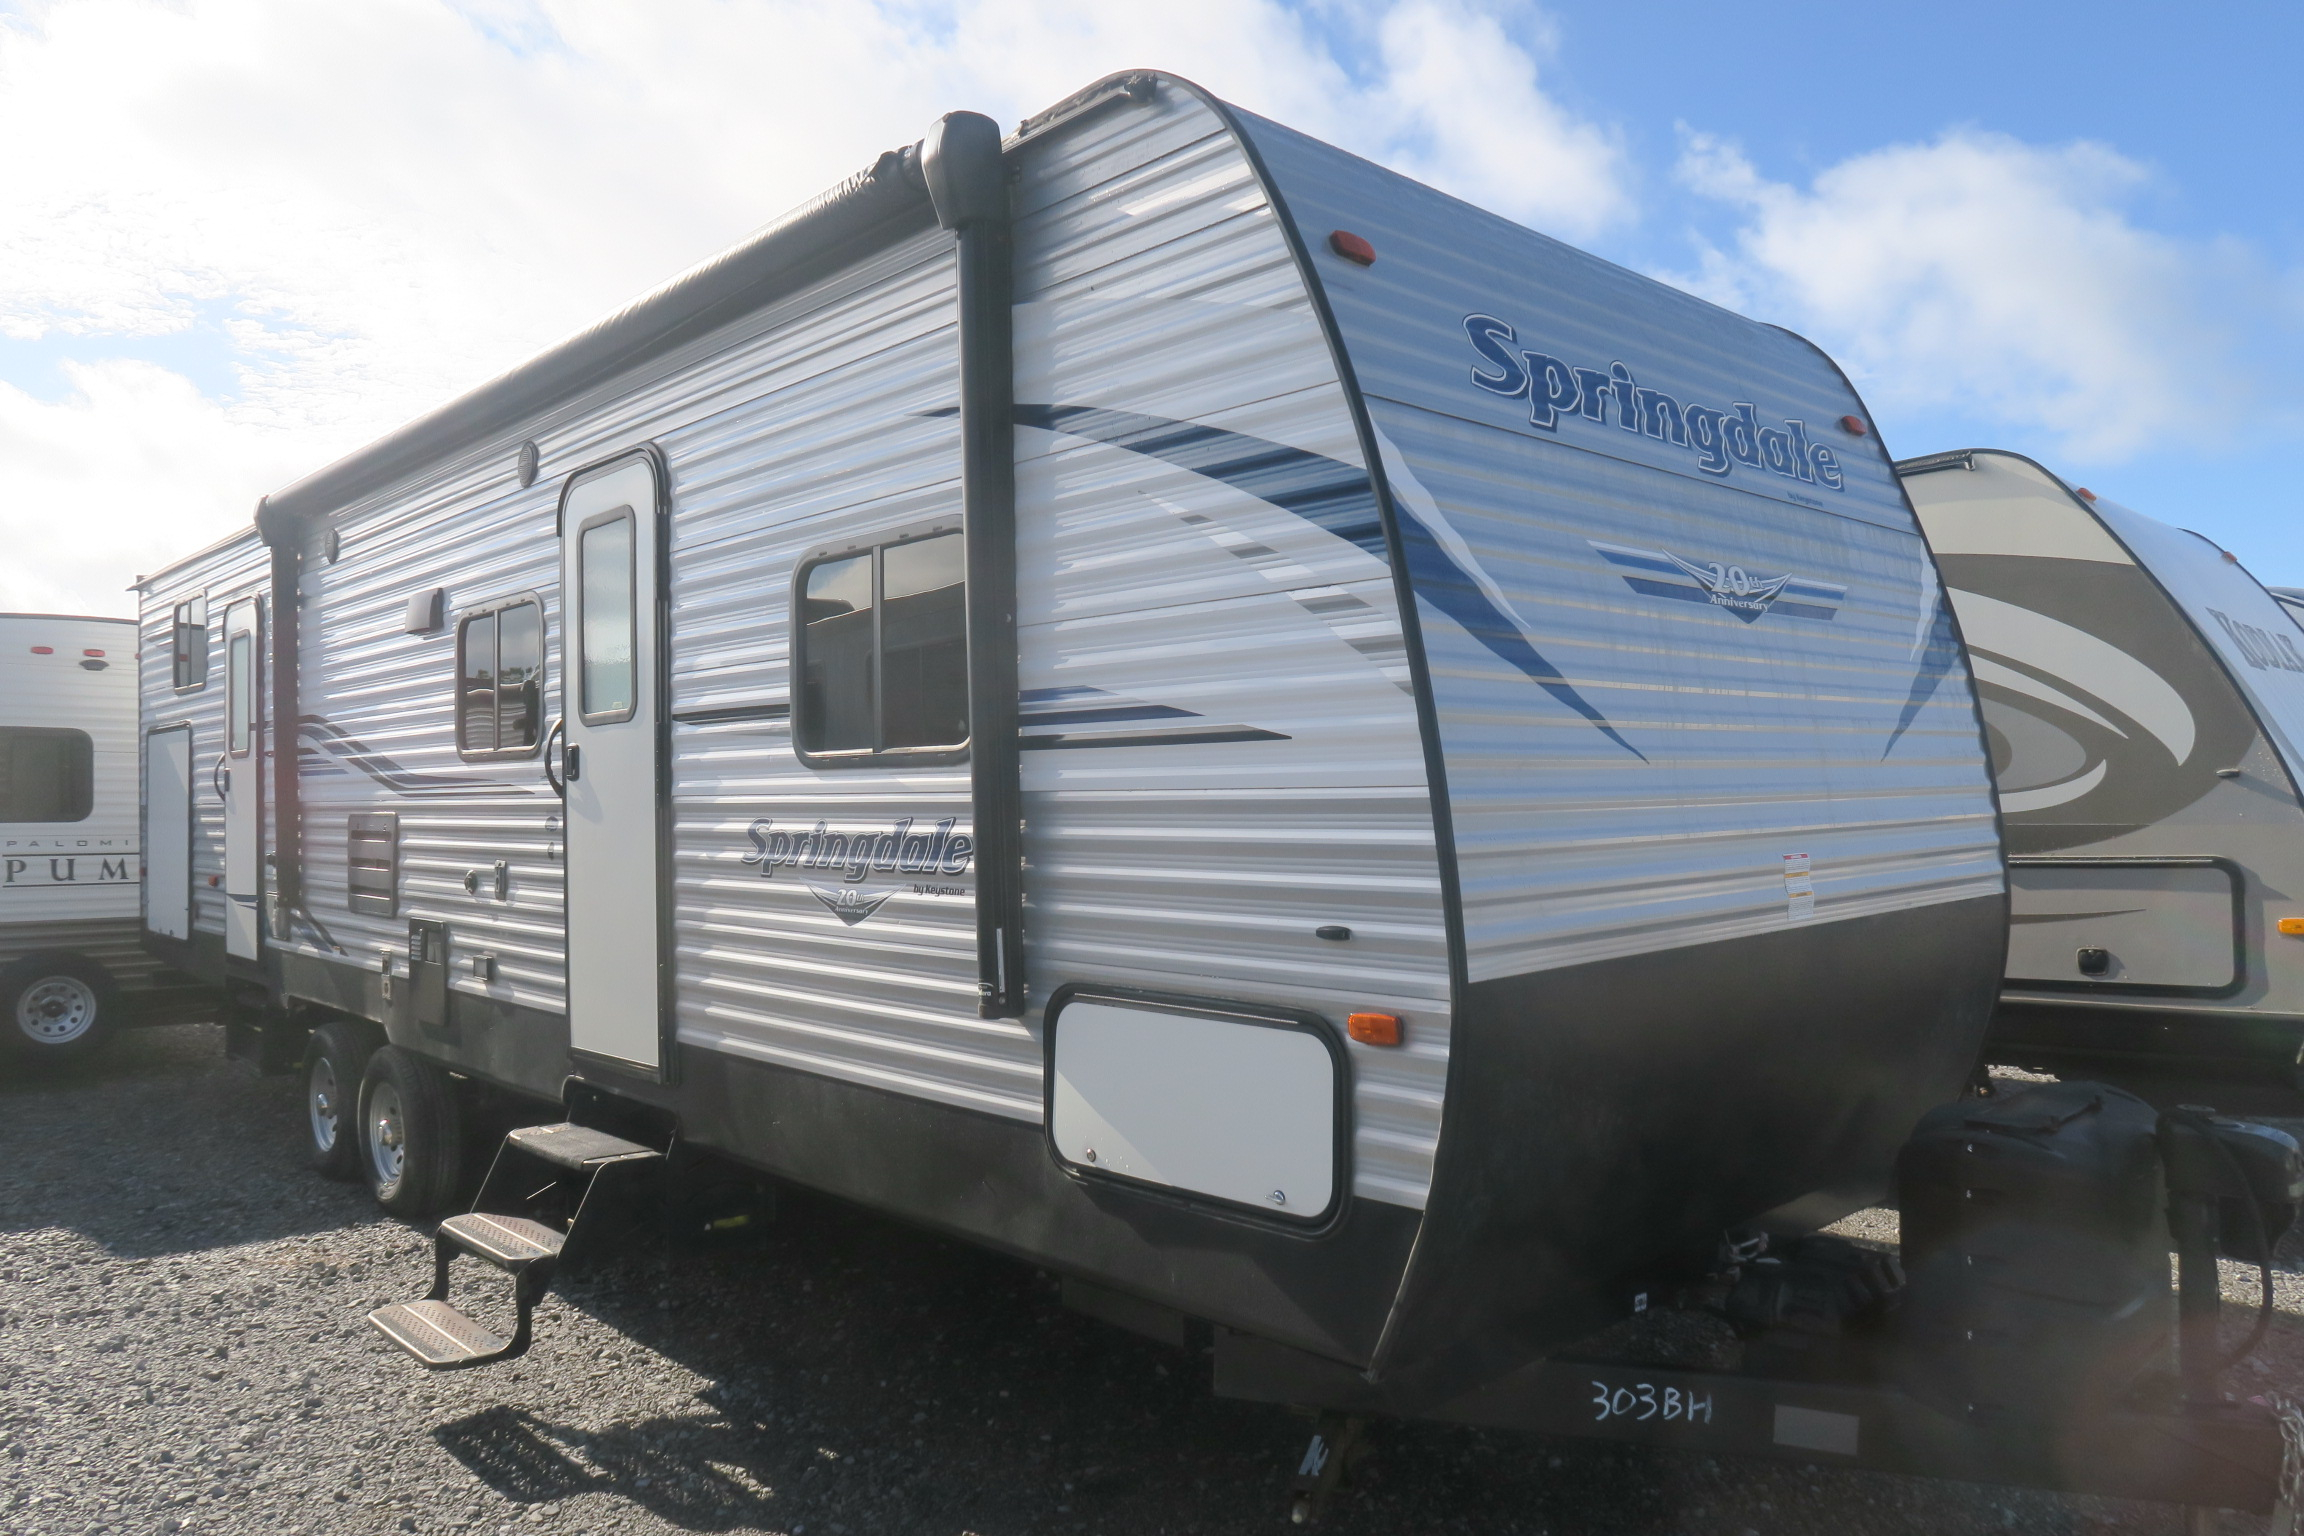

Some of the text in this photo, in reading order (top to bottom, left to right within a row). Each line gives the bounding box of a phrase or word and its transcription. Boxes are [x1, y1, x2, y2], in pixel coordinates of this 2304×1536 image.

[1462, 312, 1845, 491] Springdale
[1708, 561, 1764, 597] 20th
[1709, 594, 1770, 613] Anniversary
[741, 816, 974, 884] Springdale
[5, 857, 130, 883] PUM
[913, 883, 966, 897] by Keystone
[834, 905, 869, 915] Anniversary
[1592, 1381, 1713, 1425] 303BH
